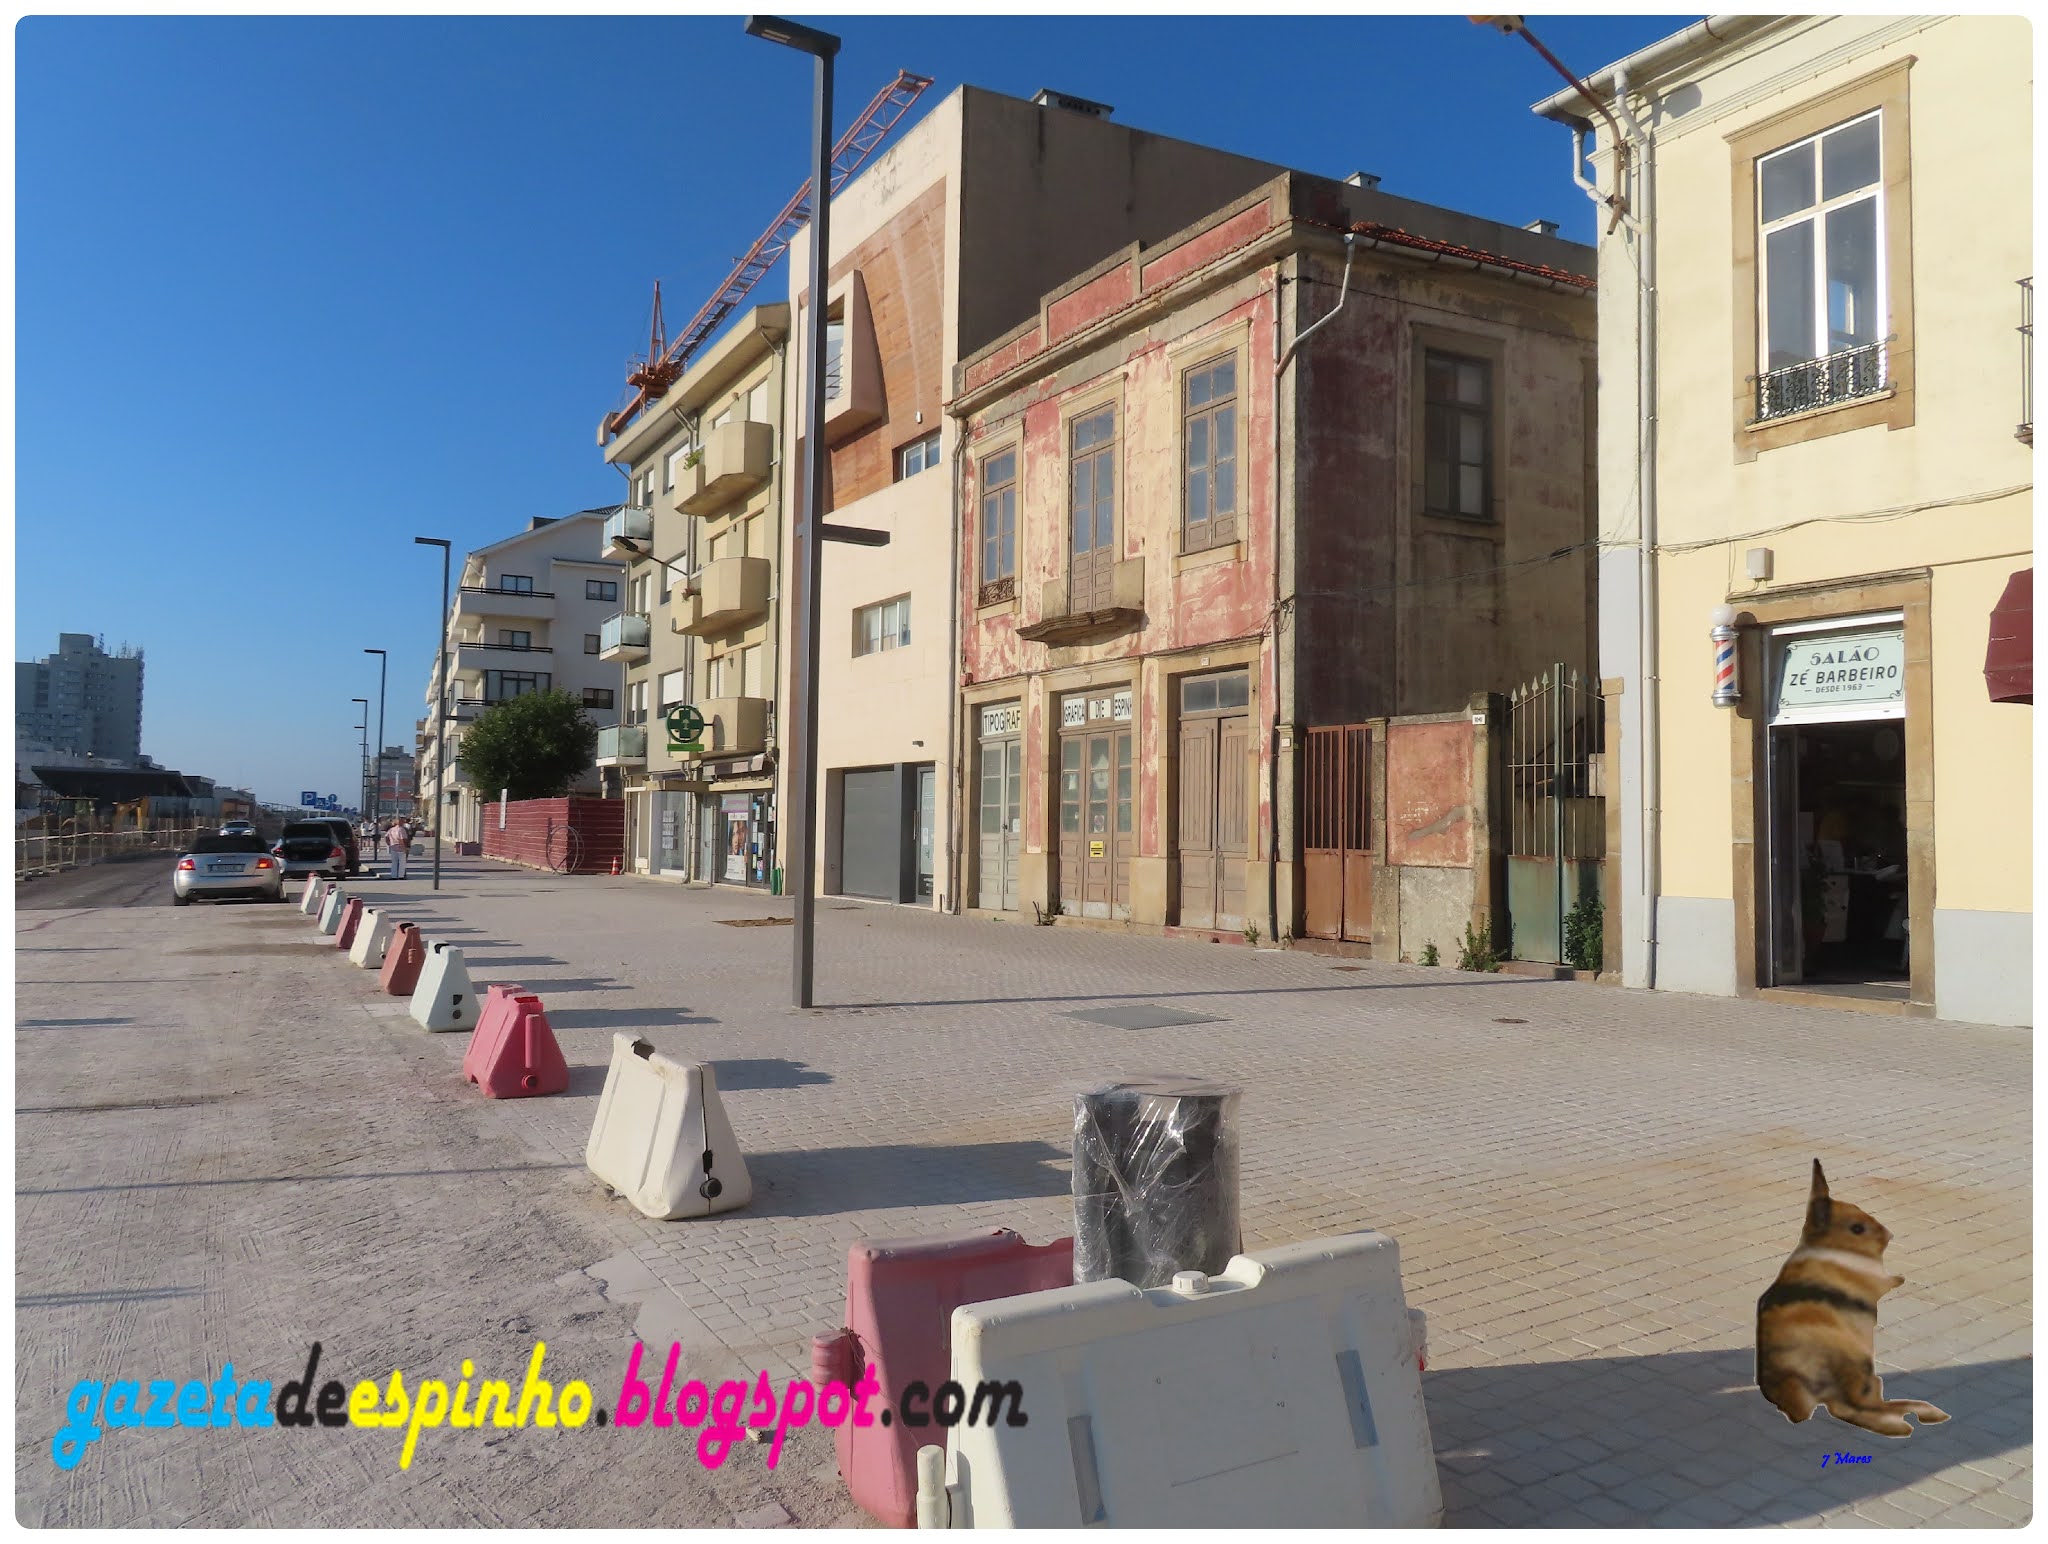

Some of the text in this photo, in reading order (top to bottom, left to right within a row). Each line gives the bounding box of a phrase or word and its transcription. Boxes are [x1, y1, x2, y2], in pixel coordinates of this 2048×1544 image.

[1810, 645, 1880, 666] SALÃO
[1789, 665, 1897, 686] ZÉ BARBEIRO
[1815, 683, 1863, 694] DESDE 1963
[1064, 701, 1085, 723] GRÁFICA
[304, 792, 314, 805] P
